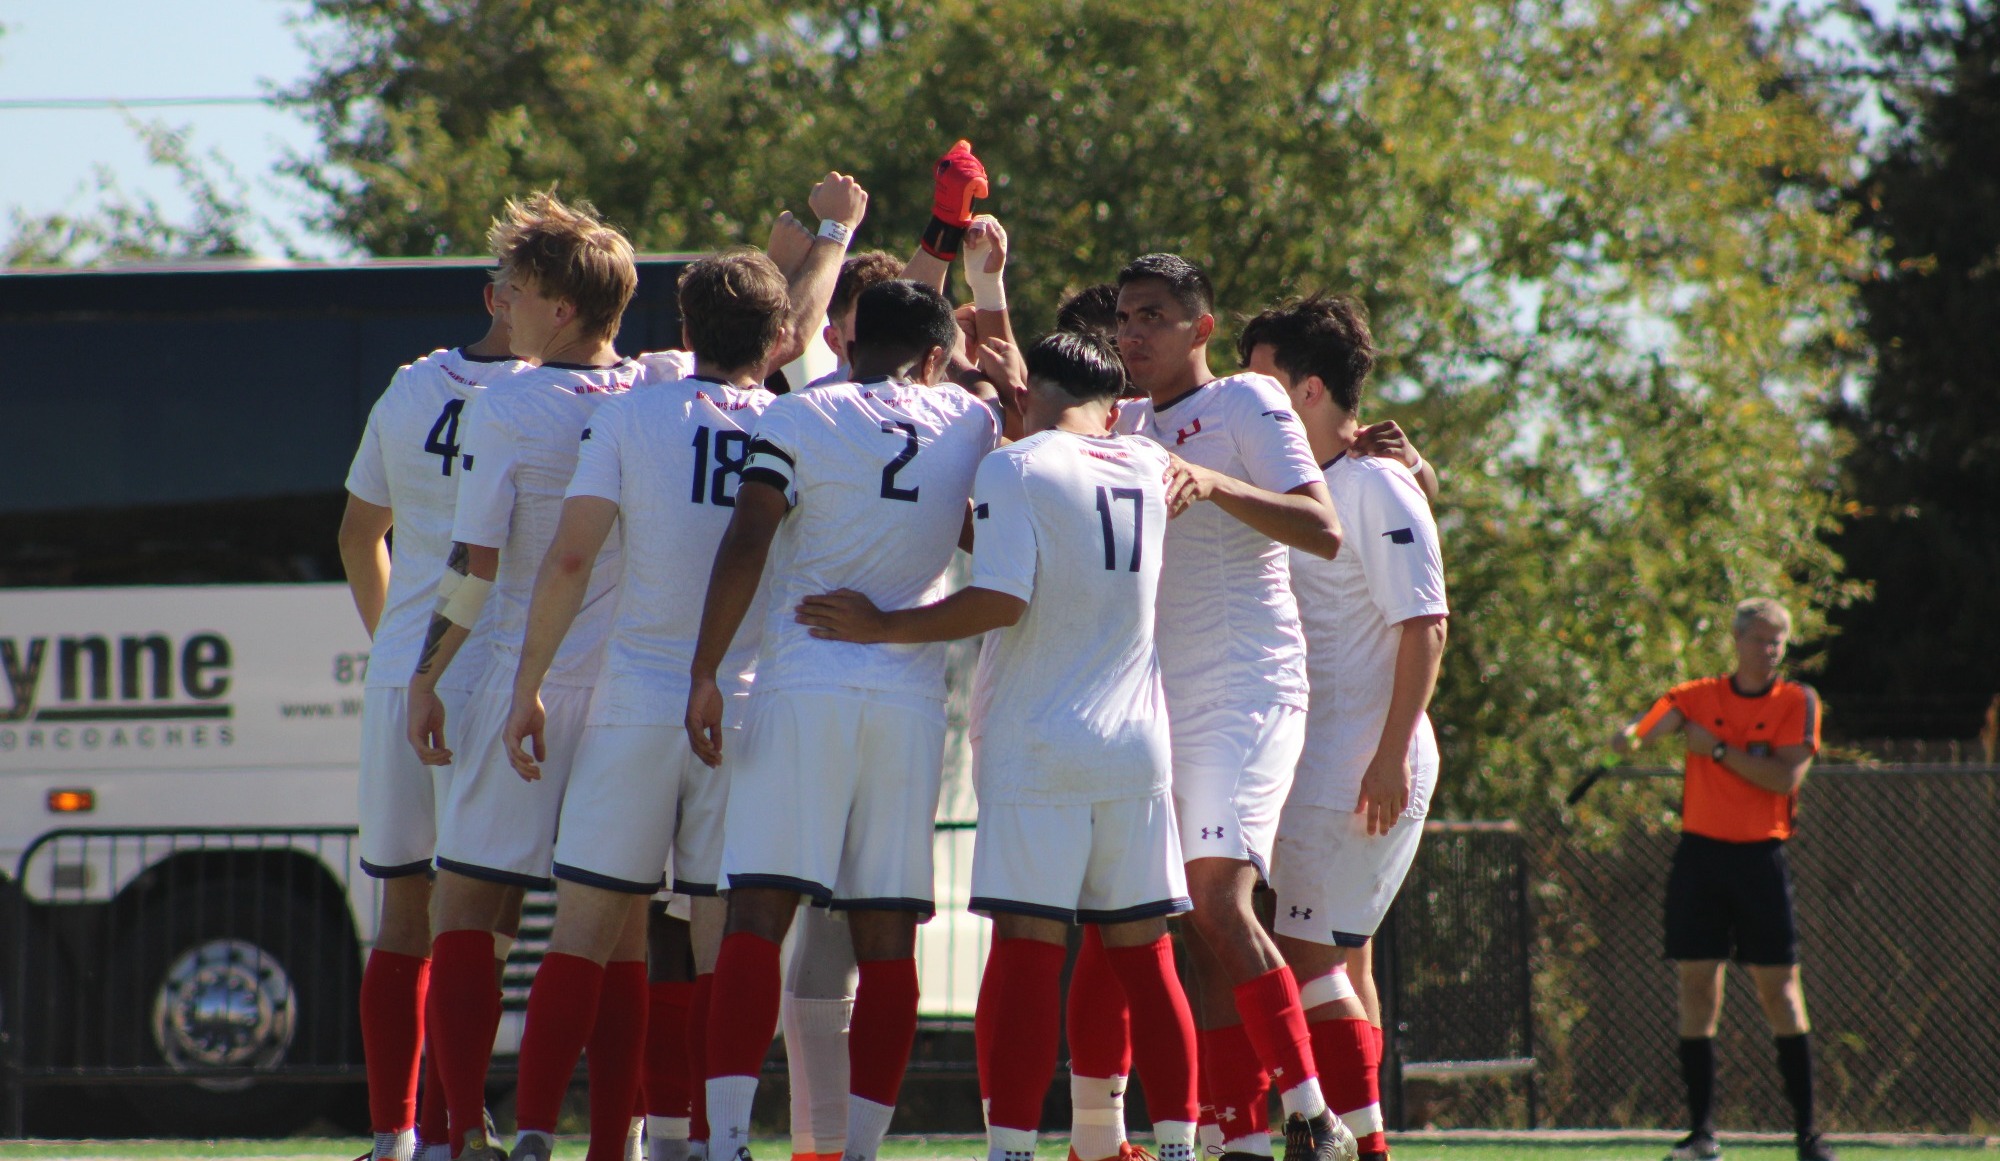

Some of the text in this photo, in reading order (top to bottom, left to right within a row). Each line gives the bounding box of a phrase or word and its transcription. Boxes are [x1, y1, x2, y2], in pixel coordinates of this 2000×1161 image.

[424, 398, 466, 477] 4
[692, 425, 751, 507] 18
[880, 420, 919, 502] 2
[1096, 485, 1144, 572] 17
[0, 632, 233, 722] ynne
